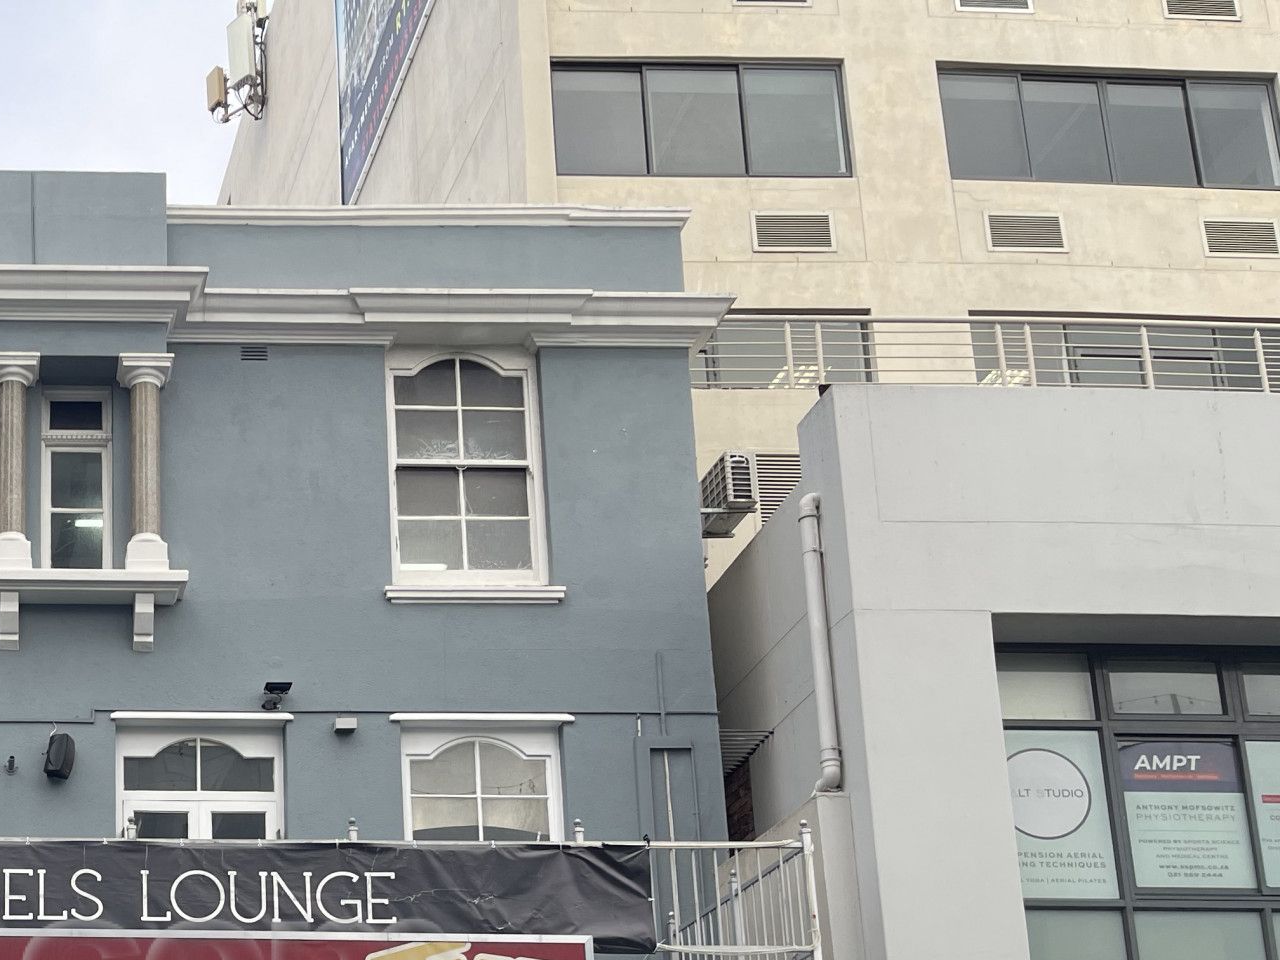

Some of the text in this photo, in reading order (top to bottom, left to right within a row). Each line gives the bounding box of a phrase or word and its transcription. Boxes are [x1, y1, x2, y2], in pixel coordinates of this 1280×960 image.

[345, 76, 378, 169] APARTMENTS
[380, 33, 394, 75] FROM
[1134, 754, 1201, 771] AMPT
[1036, 788, 1084, 798] STUDIO
[1136, 813, 1237, 822] PHYSIOTHERAPY
[140, 869, 398, 924] LOUNGE
